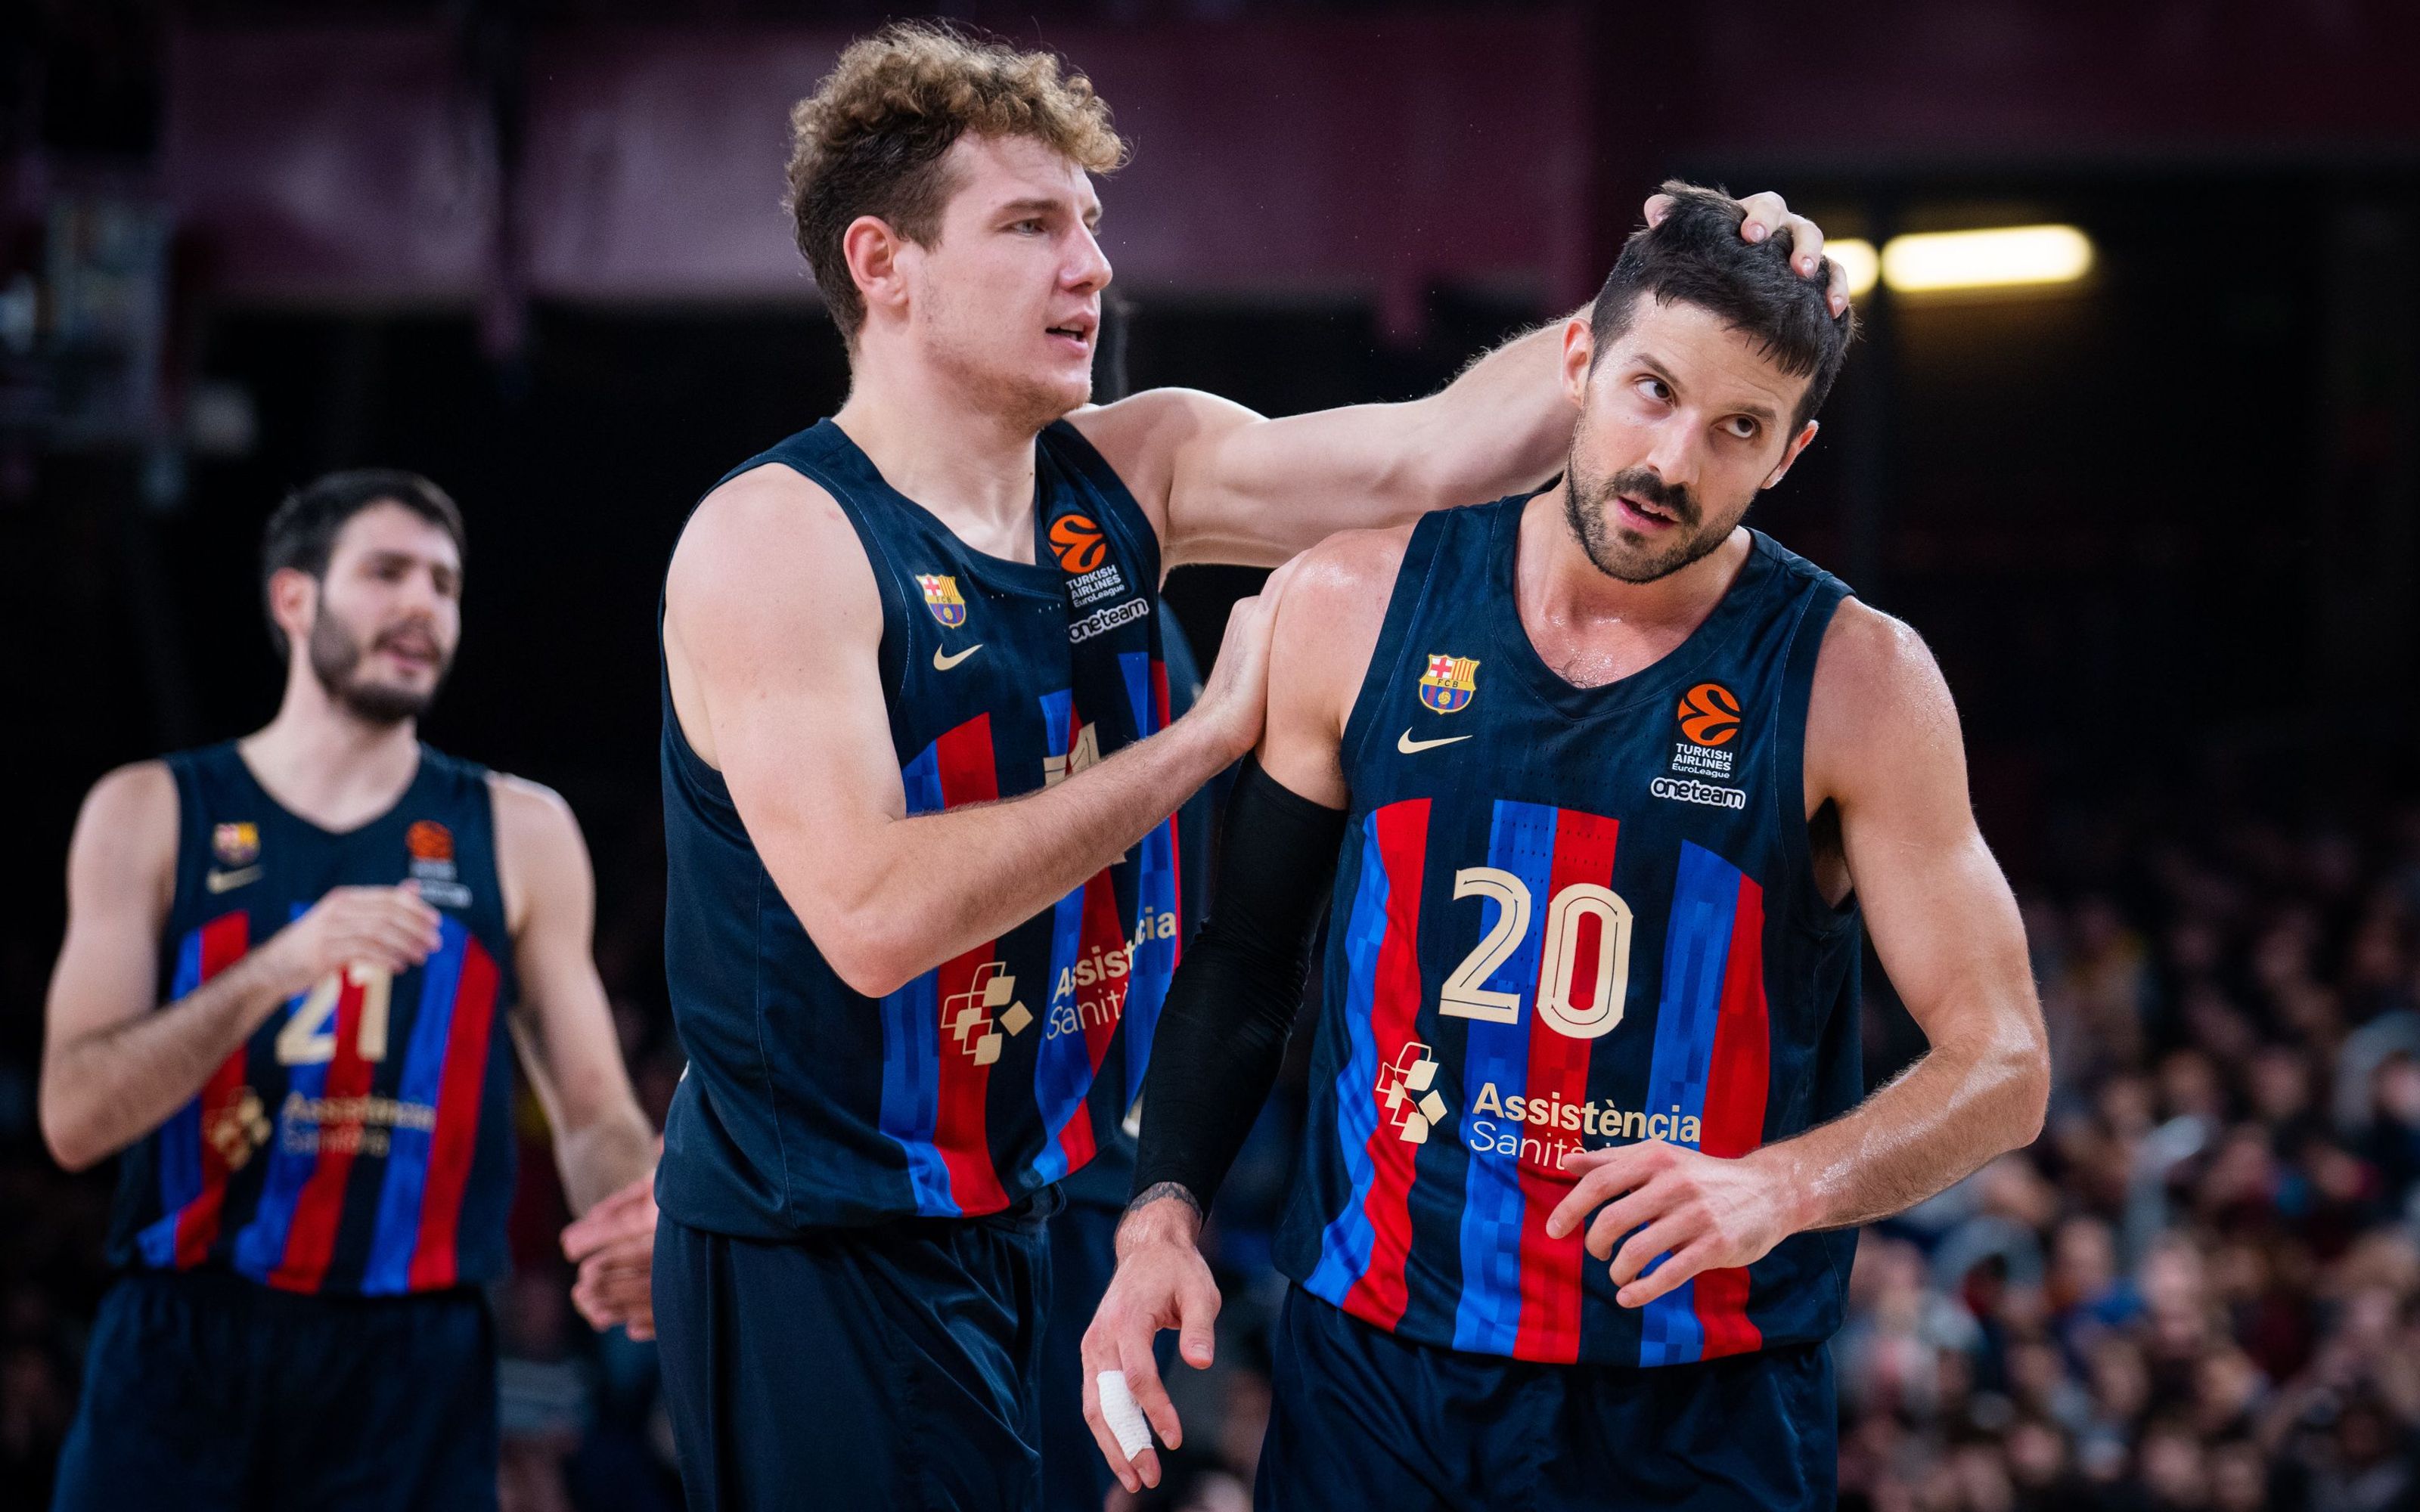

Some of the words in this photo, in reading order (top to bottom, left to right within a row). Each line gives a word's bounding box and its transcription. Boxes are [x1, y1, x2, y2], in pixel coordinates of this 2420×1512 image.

[1066, 564, 1118, 590] TURKISH
[1071, 574, 1122, 600] AIRLINES
[1073, 584, 1125, 609] EuroLeague
[1069, 598, 1150, 643] oneteam
[1673, 754, 1732, 771] AIRLINES
[1676, 743, 1733, 762] TURKISH
[1671, 763, 1730, 779] EuroLeague
[1651, 777, 1746, 810] oneteam
[1052, 906, 1177, 1005] Asistcia
[1438, 866, 1634, 1039] 20
[1047, 981, 1128, 1041] Sanit
[1472, 1083, 1701, 1142] Assistència
